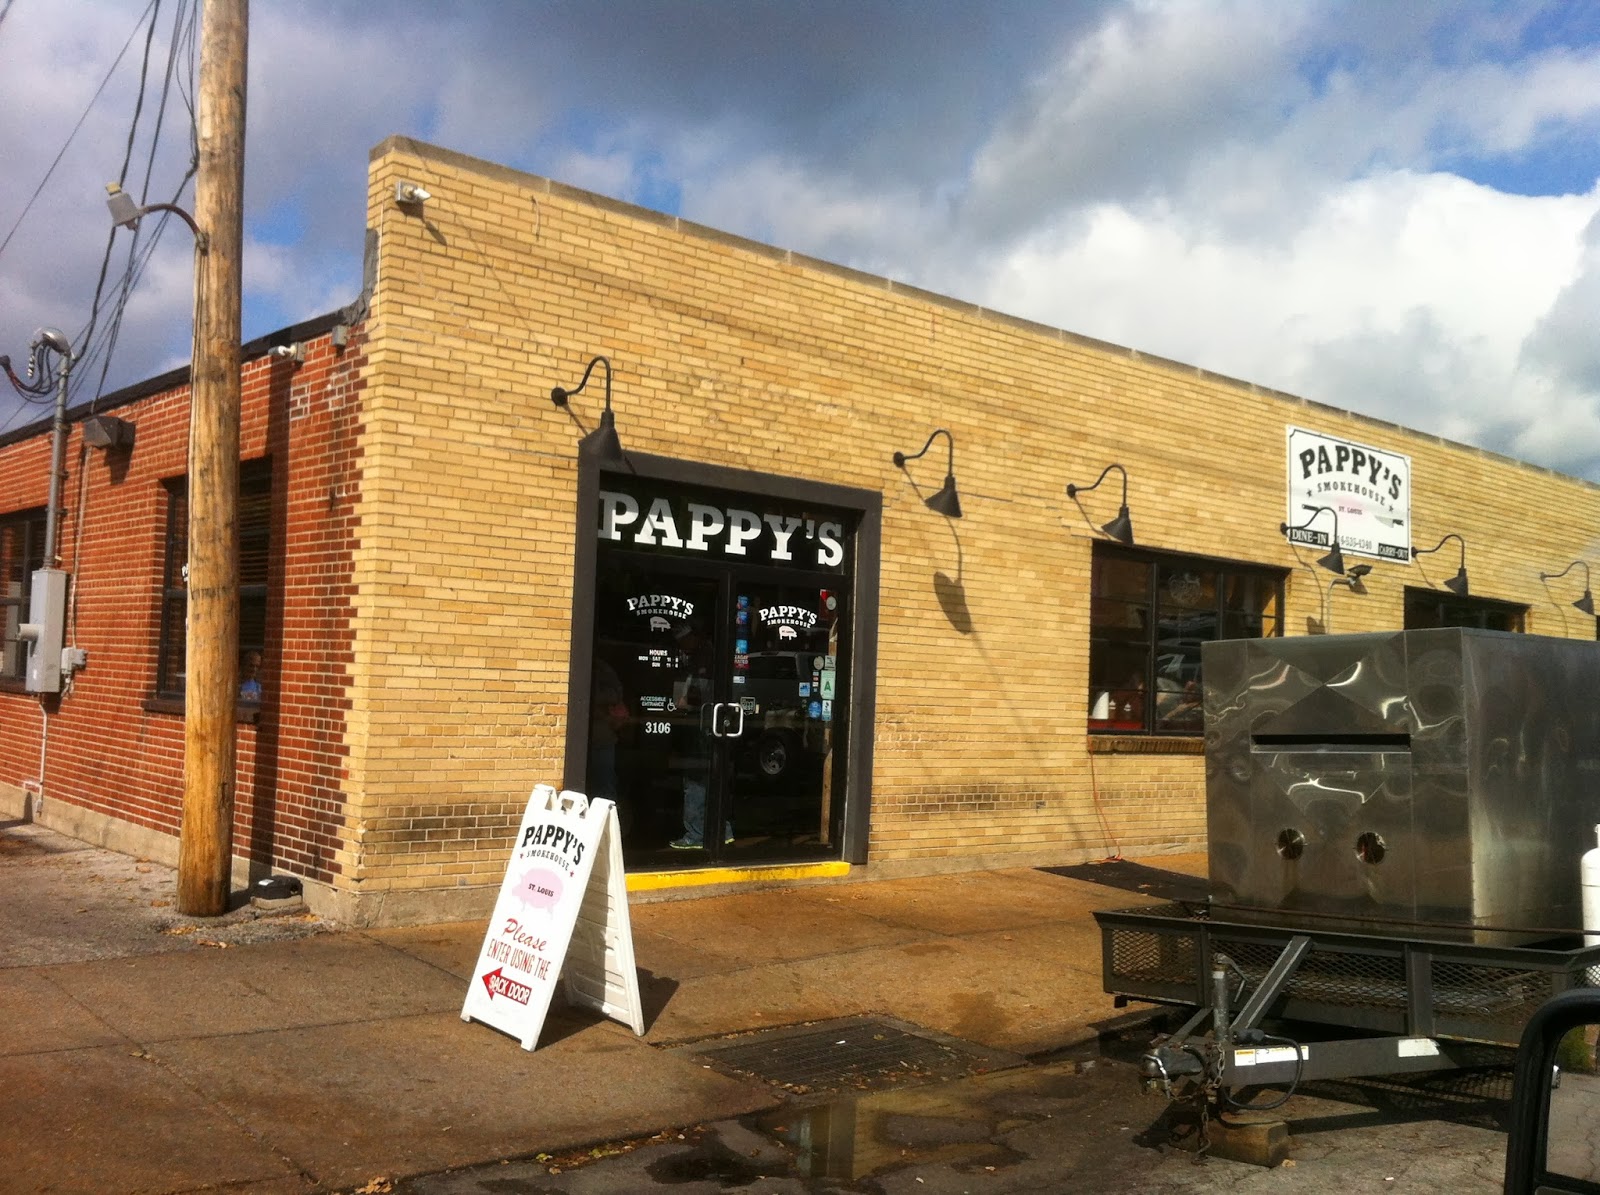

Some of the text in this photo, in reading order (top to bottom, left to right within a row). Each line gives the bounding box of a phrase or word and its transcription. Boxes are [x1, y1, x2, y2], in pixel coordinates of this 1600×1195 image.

[1299, 445, 1402, 501] PAPPY'S
[1317, 481, 1386, 507] SMOKEHOUSE
[597, 490, 843, 567] PAPPY'S
[1292, 529, 1328, 546] DINE-IN
[626, 594, 695, 616] PAPPY'S
[636, 608, 687, 620] SMOKEHOUSE
[759, 605, 818, 626] PAPPY'S
[767, 618, 811, 629] SMOKEHOUSE
[823, 681, 832, 692] A
[645, 721, 671, 734] 3106
[521, 824, 586, 866] PAPPY'S
[526, 849, 570, 871] SMOKEHOUSE
[528, 883, 555, 898] ST. LOUIS
[501, 917, 547, 952] Please
[486, 938, 551, 981] ENTER USING THE
[489, 974, 530, 1005] BACK DOOR
